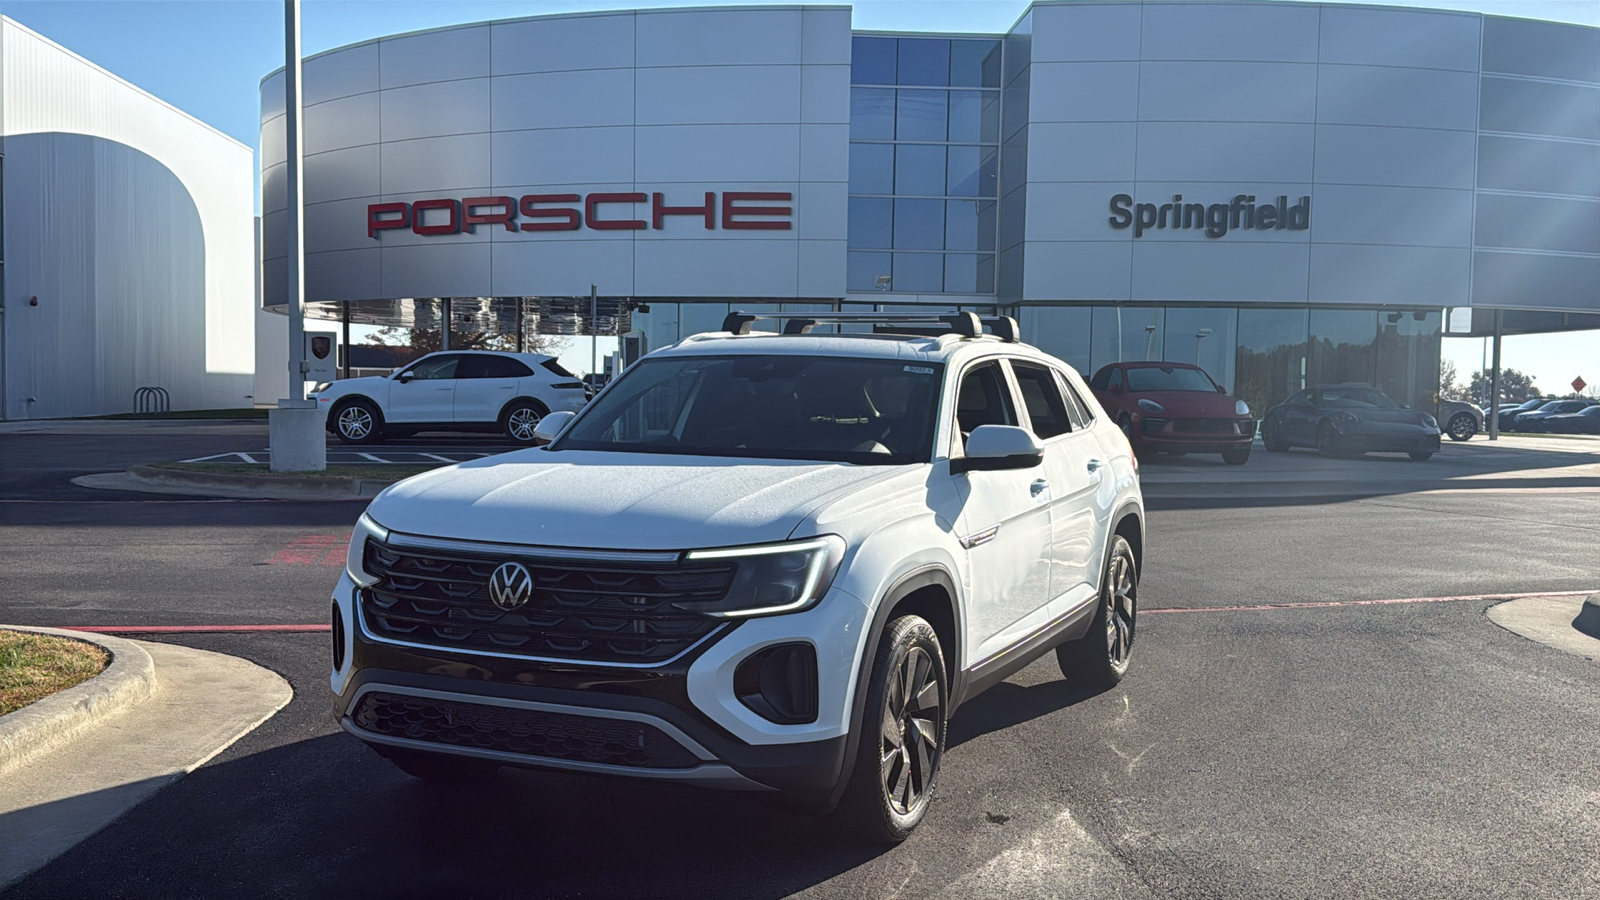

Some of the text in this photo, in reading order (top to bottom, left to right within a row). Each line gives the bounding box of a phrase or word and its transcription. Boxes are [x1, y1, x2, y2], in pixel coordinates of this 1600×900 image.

[368, 192, 792, 238] PORSCHE
[1109, 194, 1310, 238] Springfield
[490, 563, 530, 609] VW
